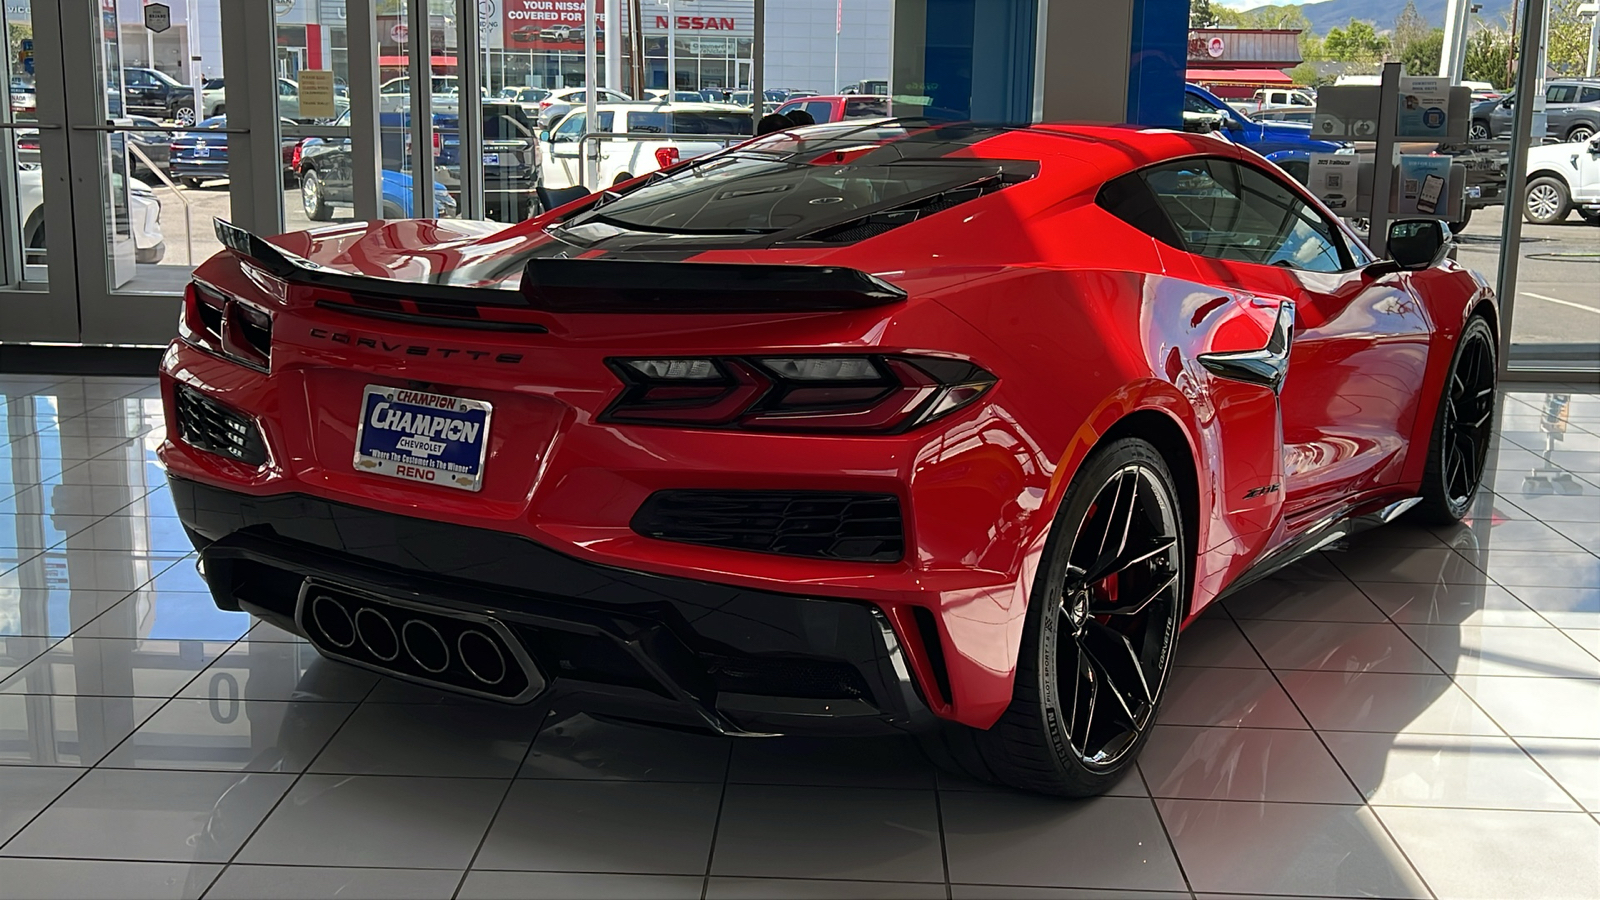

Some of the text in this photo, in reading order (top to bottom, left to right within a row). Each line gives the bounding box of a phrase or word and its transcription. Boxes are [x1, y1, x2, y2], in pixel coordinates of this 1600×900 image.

[523, 0, 586, 10] YOUR NISSA
[508, 10, 559, 20] COVERED
[560, 12, 582, 21] FOR
[656, 15, 735, 31] NSSAN
[310, 327, 524, 364] CORVETTE
[396, 390, 457, 410] CHAMPION
[370, 402, 480, 444] CHAMPION
[399, 440, 443, 453] CHEVROLET
[391, 452, 402, 462] The
[402, 454, 430, 466] Customer
[436, 460, 448, 470] The
[396, 465, 436, 481] RENO
